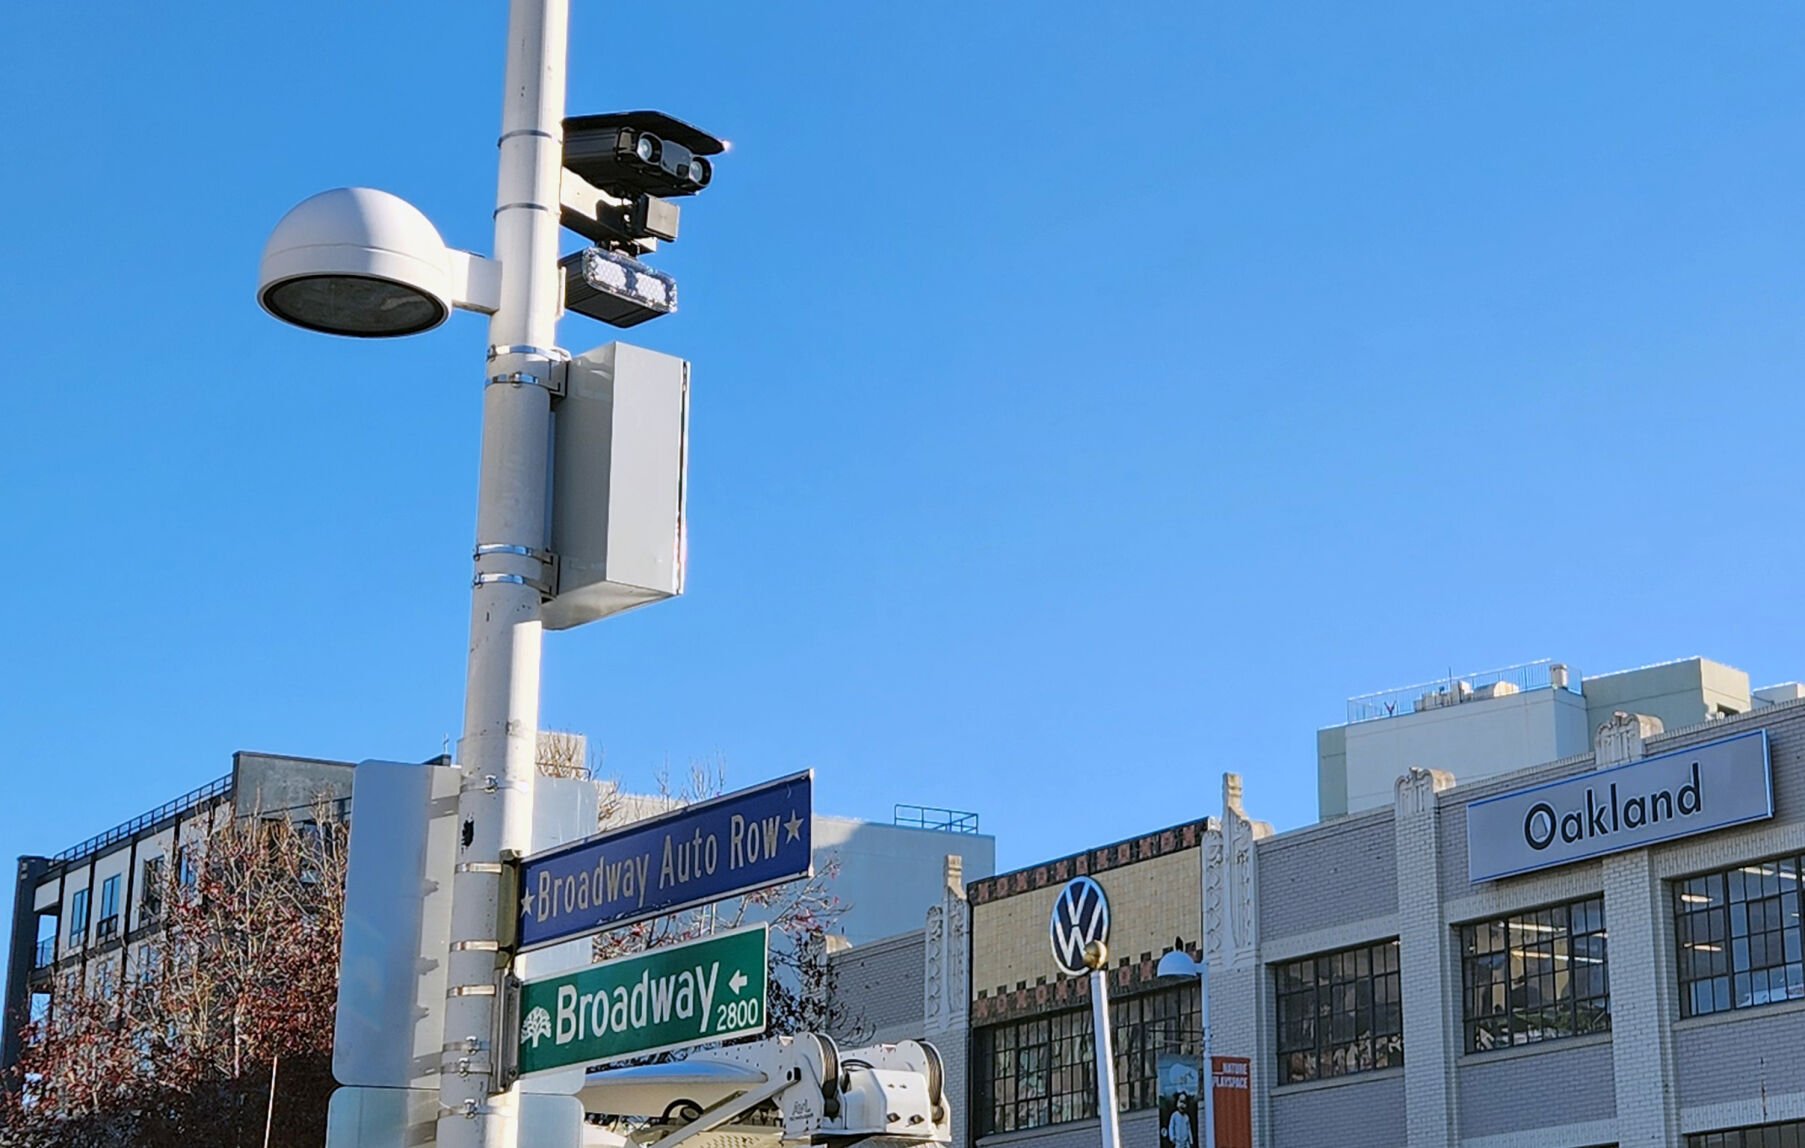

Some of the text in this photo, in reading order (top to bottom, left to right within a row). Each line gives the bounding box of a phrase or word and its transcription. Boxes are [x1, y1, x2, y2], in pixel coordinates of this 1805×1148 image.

[1524, 762, 1702, 850] Oakland
[537, 814, 780, 922] Broadway Auto Row
[555, 961, 758, 1046] Broadway 2800
